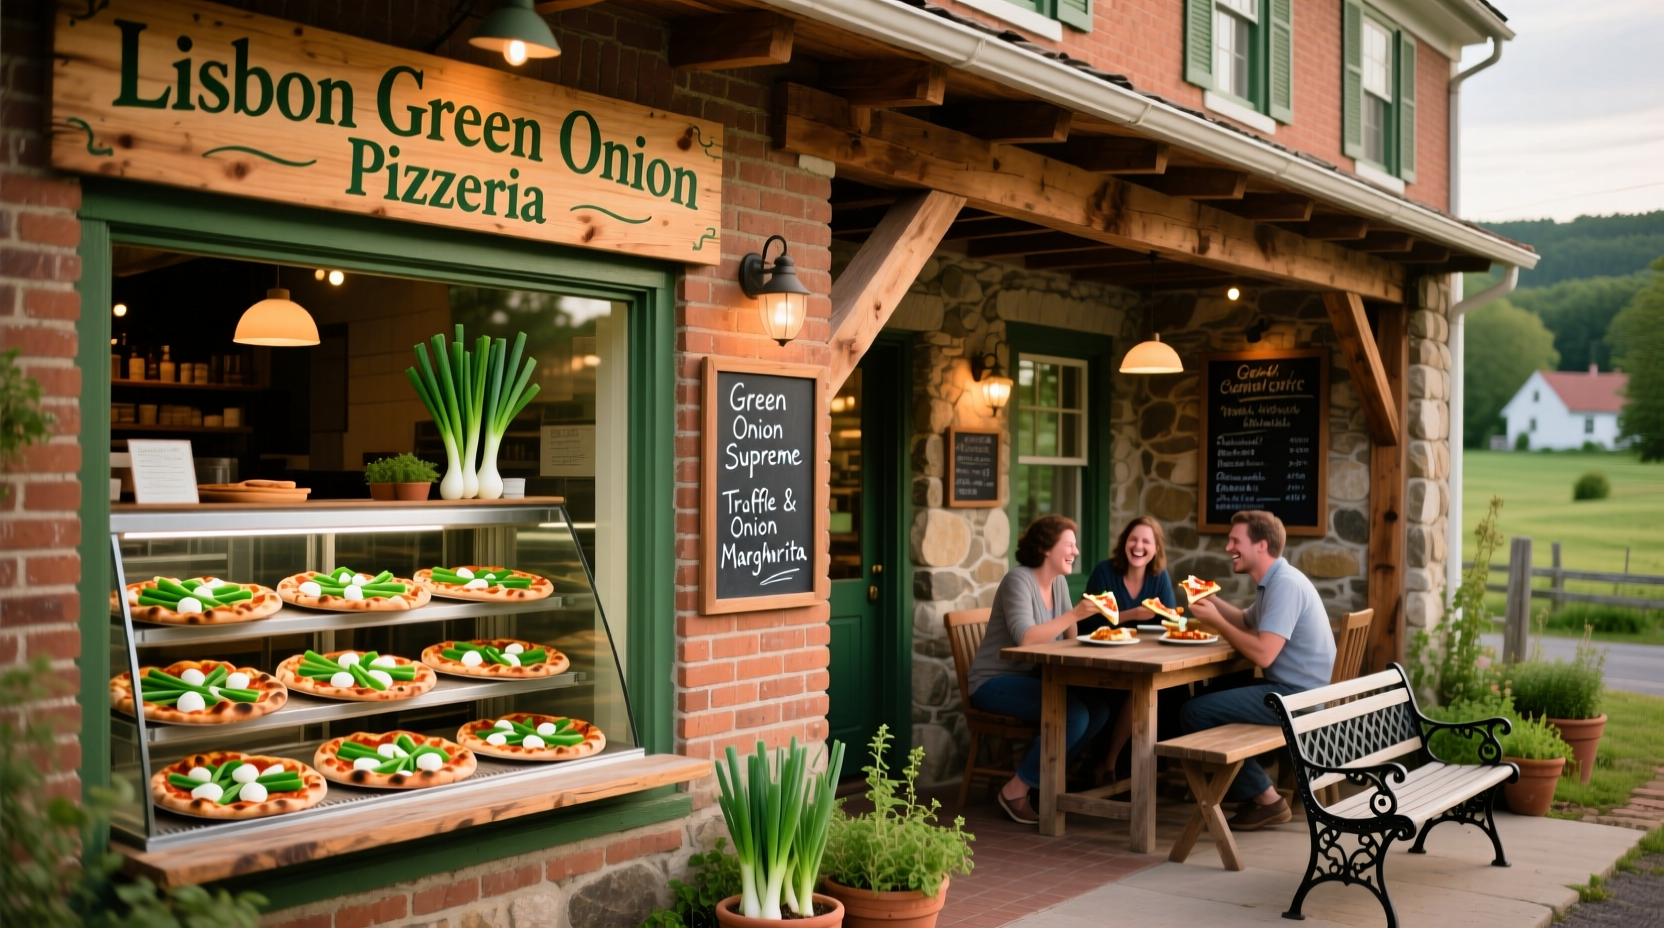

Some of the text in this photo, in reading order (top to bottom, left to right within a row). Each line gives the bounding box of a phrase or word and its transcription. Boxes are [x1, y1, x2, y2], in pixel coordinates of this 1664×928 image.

[113, 19, 699, 210] Lisbon Green Onion
[346, 137, 546, 224] Pizzeria
[730, 382, 786, 411] Green
[732, 414, 783, 440] Onion
[725, 443, 802, 478] Supreme
[783, 487, 796, 512] &
[730, 516, 777, 538] Onion
